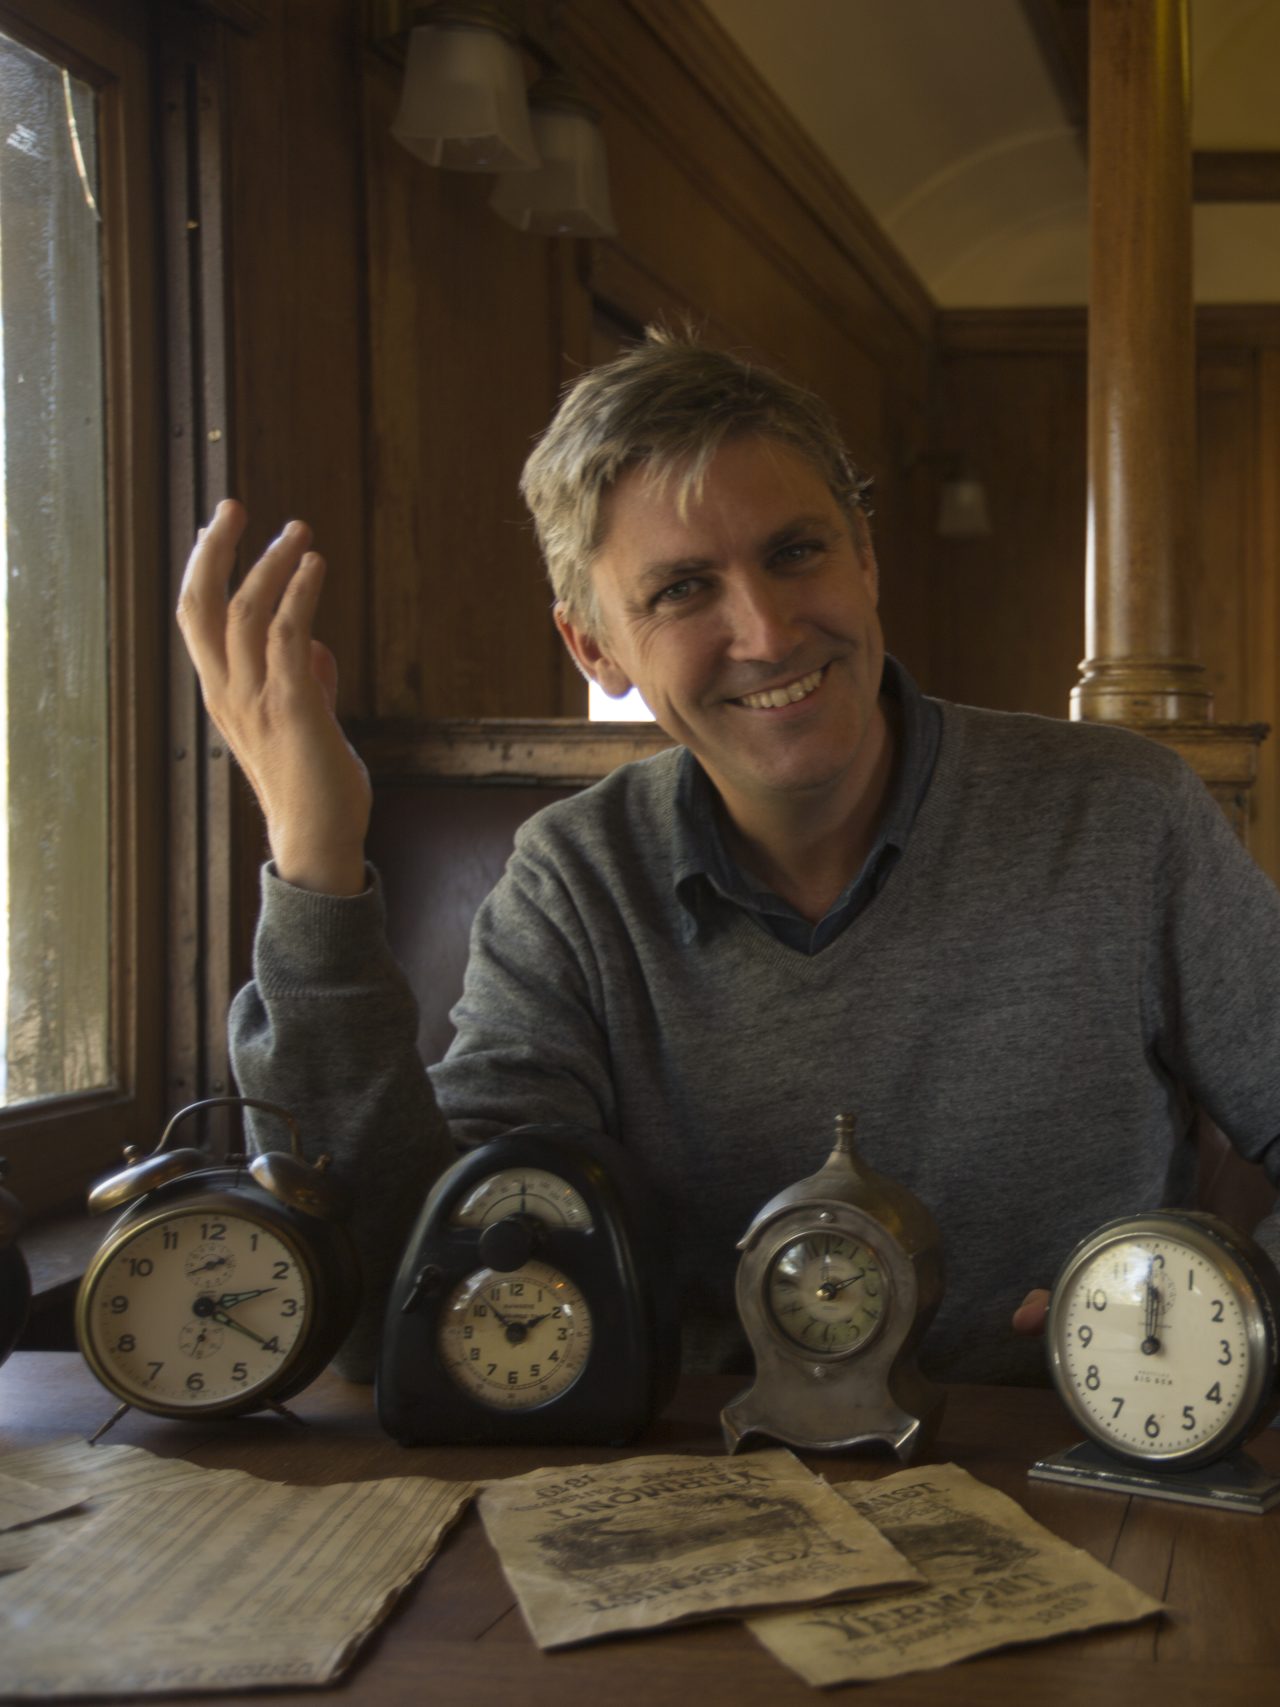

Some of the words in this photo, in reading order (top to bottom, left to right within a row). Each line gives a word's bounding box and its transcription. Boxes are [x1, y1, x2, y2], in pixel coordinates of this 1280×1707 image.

[201, 1224, 226, 1240] 12
[163, 1232, 179, 1250] 11
[251, 1234, 258, 1252] 1
[130, 1259, 154, 1276] 10
[273, 1262, 289, 1279] 2
[1188, 1269, 1193, 1291] 1
[491, 1288, 500, 1301] 11
[510, 1284, 524, 1297] 12
[112, 1297, 128, 1314] 9
[281, 1300, 298, 1317] 3
[1086, 1289, 1107, 1311] 10
[474, 1305, 487, 1317] 10
[552, 1307, 562, 1319] 2
[1211, 1300, 1224, 1322] 2
[464, 1326, 474, 1339] 9
[557, 1328, 568, 1341] 3
[1078, 1325, 1093, 1348] 9
[119, 1335, 136, 1352] 8
[262, 1336, 279, 1354] 4
[548, 1350, 560, 1362] 4
[1218, 1340, 1232, 1366] 3
[147, 1362, 163, 1380] 7
[231, 1363, 247, 1381] 5
[487, 1364, 498, 1376] 7
[508, 1371, 518, 1385] 6
[530, 1364, 541, 1377] 5
[1085, 1365, 1100, 1390] 8
[186, 1374, 205, 1391] 6
[1205, 1382, 1222, 1404] 4
[1112, 1397, 1124, 1418] 7
[1145, 1414, 1160, 1438] 6
[1181, 1406, 1196, 1431] 5
[551, 1469, 772, 1520] VERMONT
